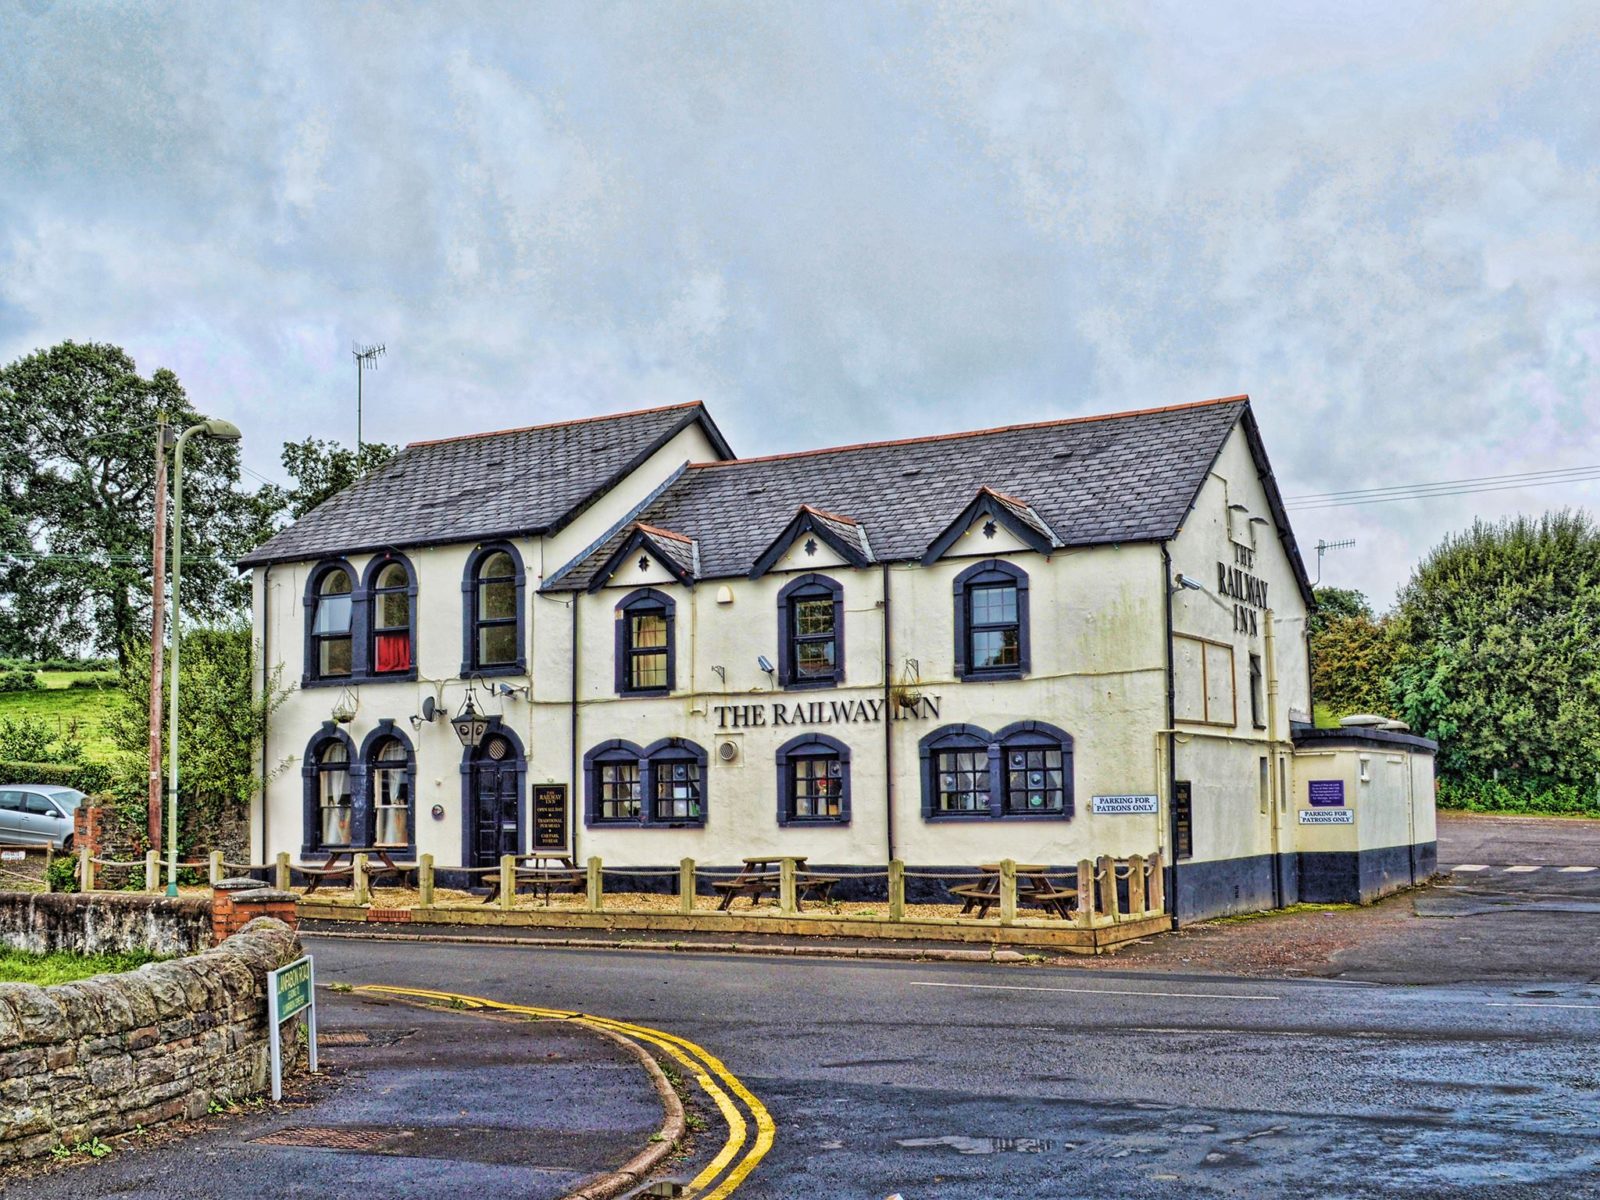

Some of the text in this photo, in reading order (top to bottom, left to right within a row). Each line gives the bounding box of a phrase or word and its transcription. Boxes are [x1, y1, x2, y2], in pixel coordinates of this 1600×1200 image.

[1233, 543, 1254, 568] THE
[1217, 561, 1268, 609] RAILWAY
[1233, 603, 1257, 637] INN
[714, 704, 766, 728] THE
[771, 698, 886, 726] RAILWAY
